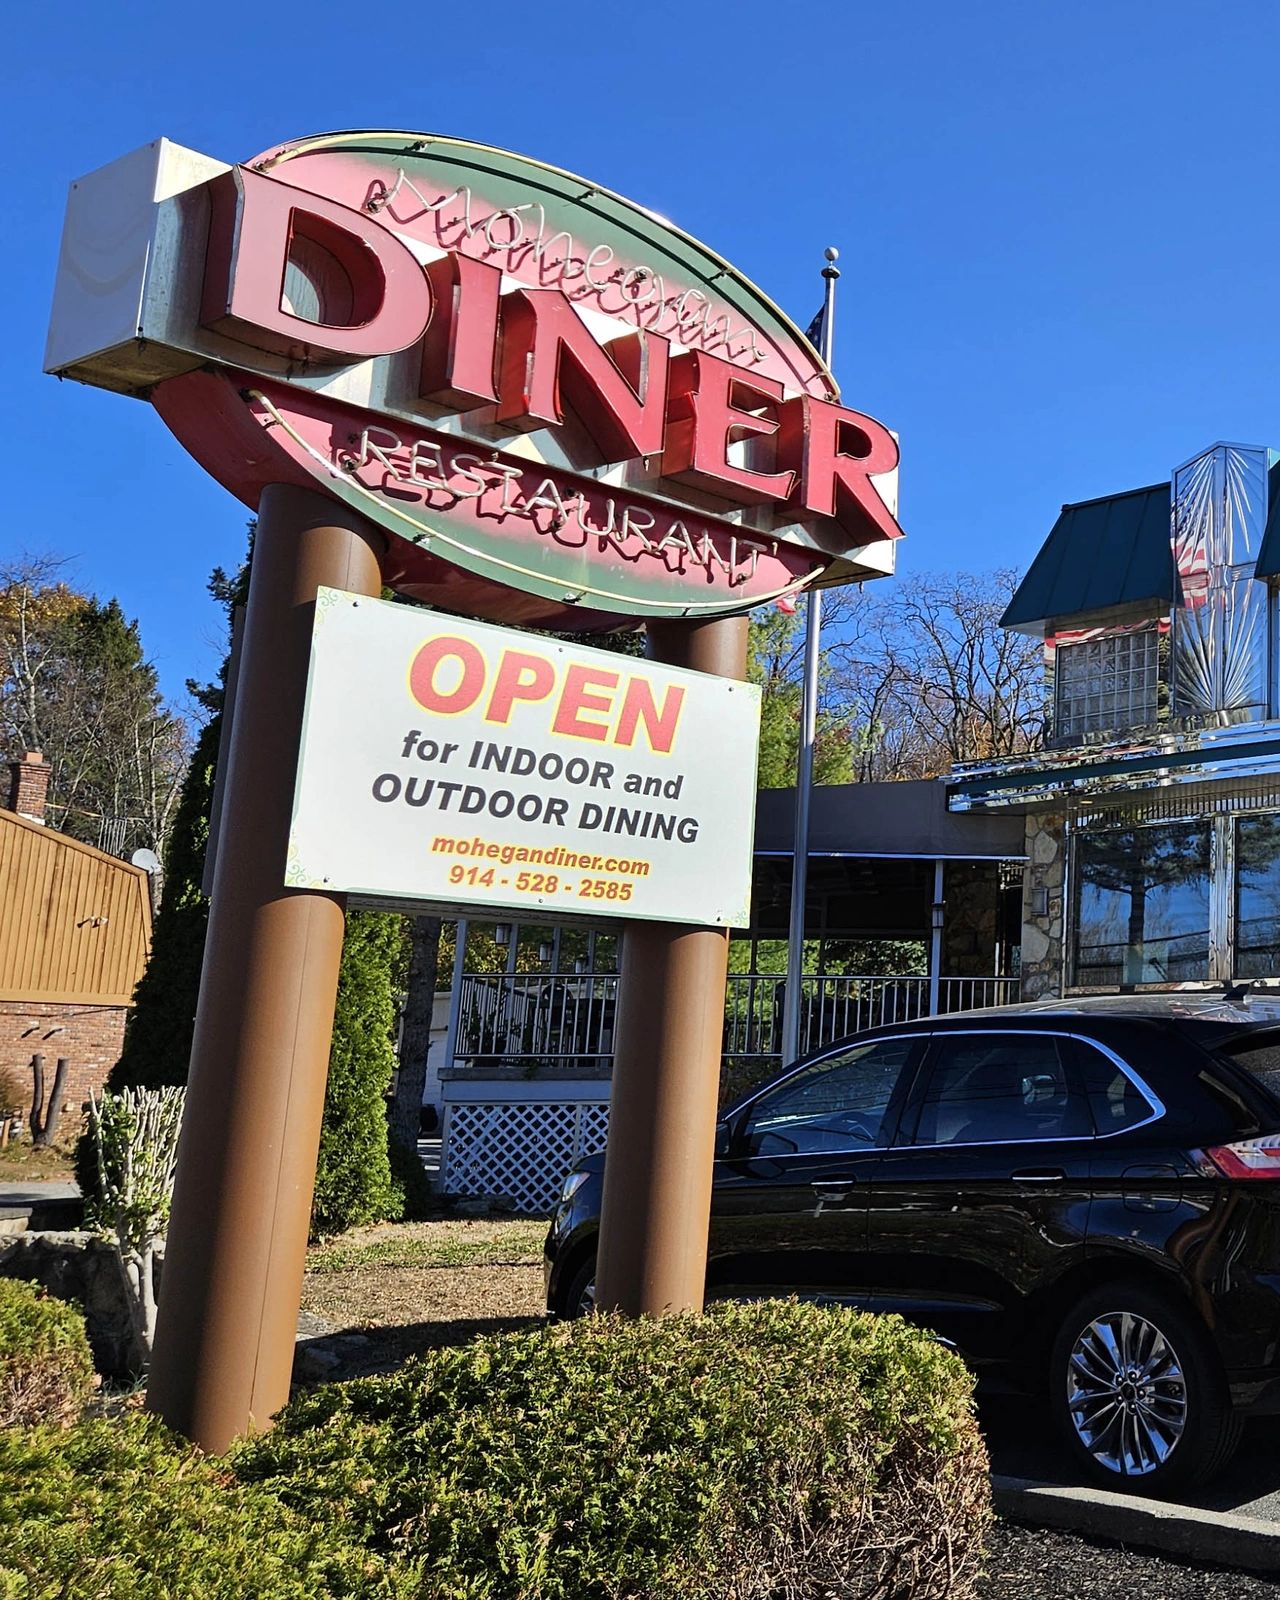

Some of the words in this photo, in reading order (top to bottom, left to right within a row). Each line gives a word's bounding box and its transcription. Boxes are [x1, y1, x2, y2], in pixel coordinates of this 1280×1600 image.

[230, 163, 904, 540] DINER
[345, 424, 779, 584] RESTAURANT
[409, 635, 686, 754] OPEN
[401, 730, 458, 764] for
[468, 741, 615, 789] INDOOR
[624, 771, 684, 800] and
[372, 773, 569, 826] OUTDOOR
[579, 803, 700, 844] DINING
[431, 836, 650, 876] mohegandiner.com
[449, 865, 495, 888] 914
[515, 873, 558, 895] 528
[579, 880, 633, 902] 2585
